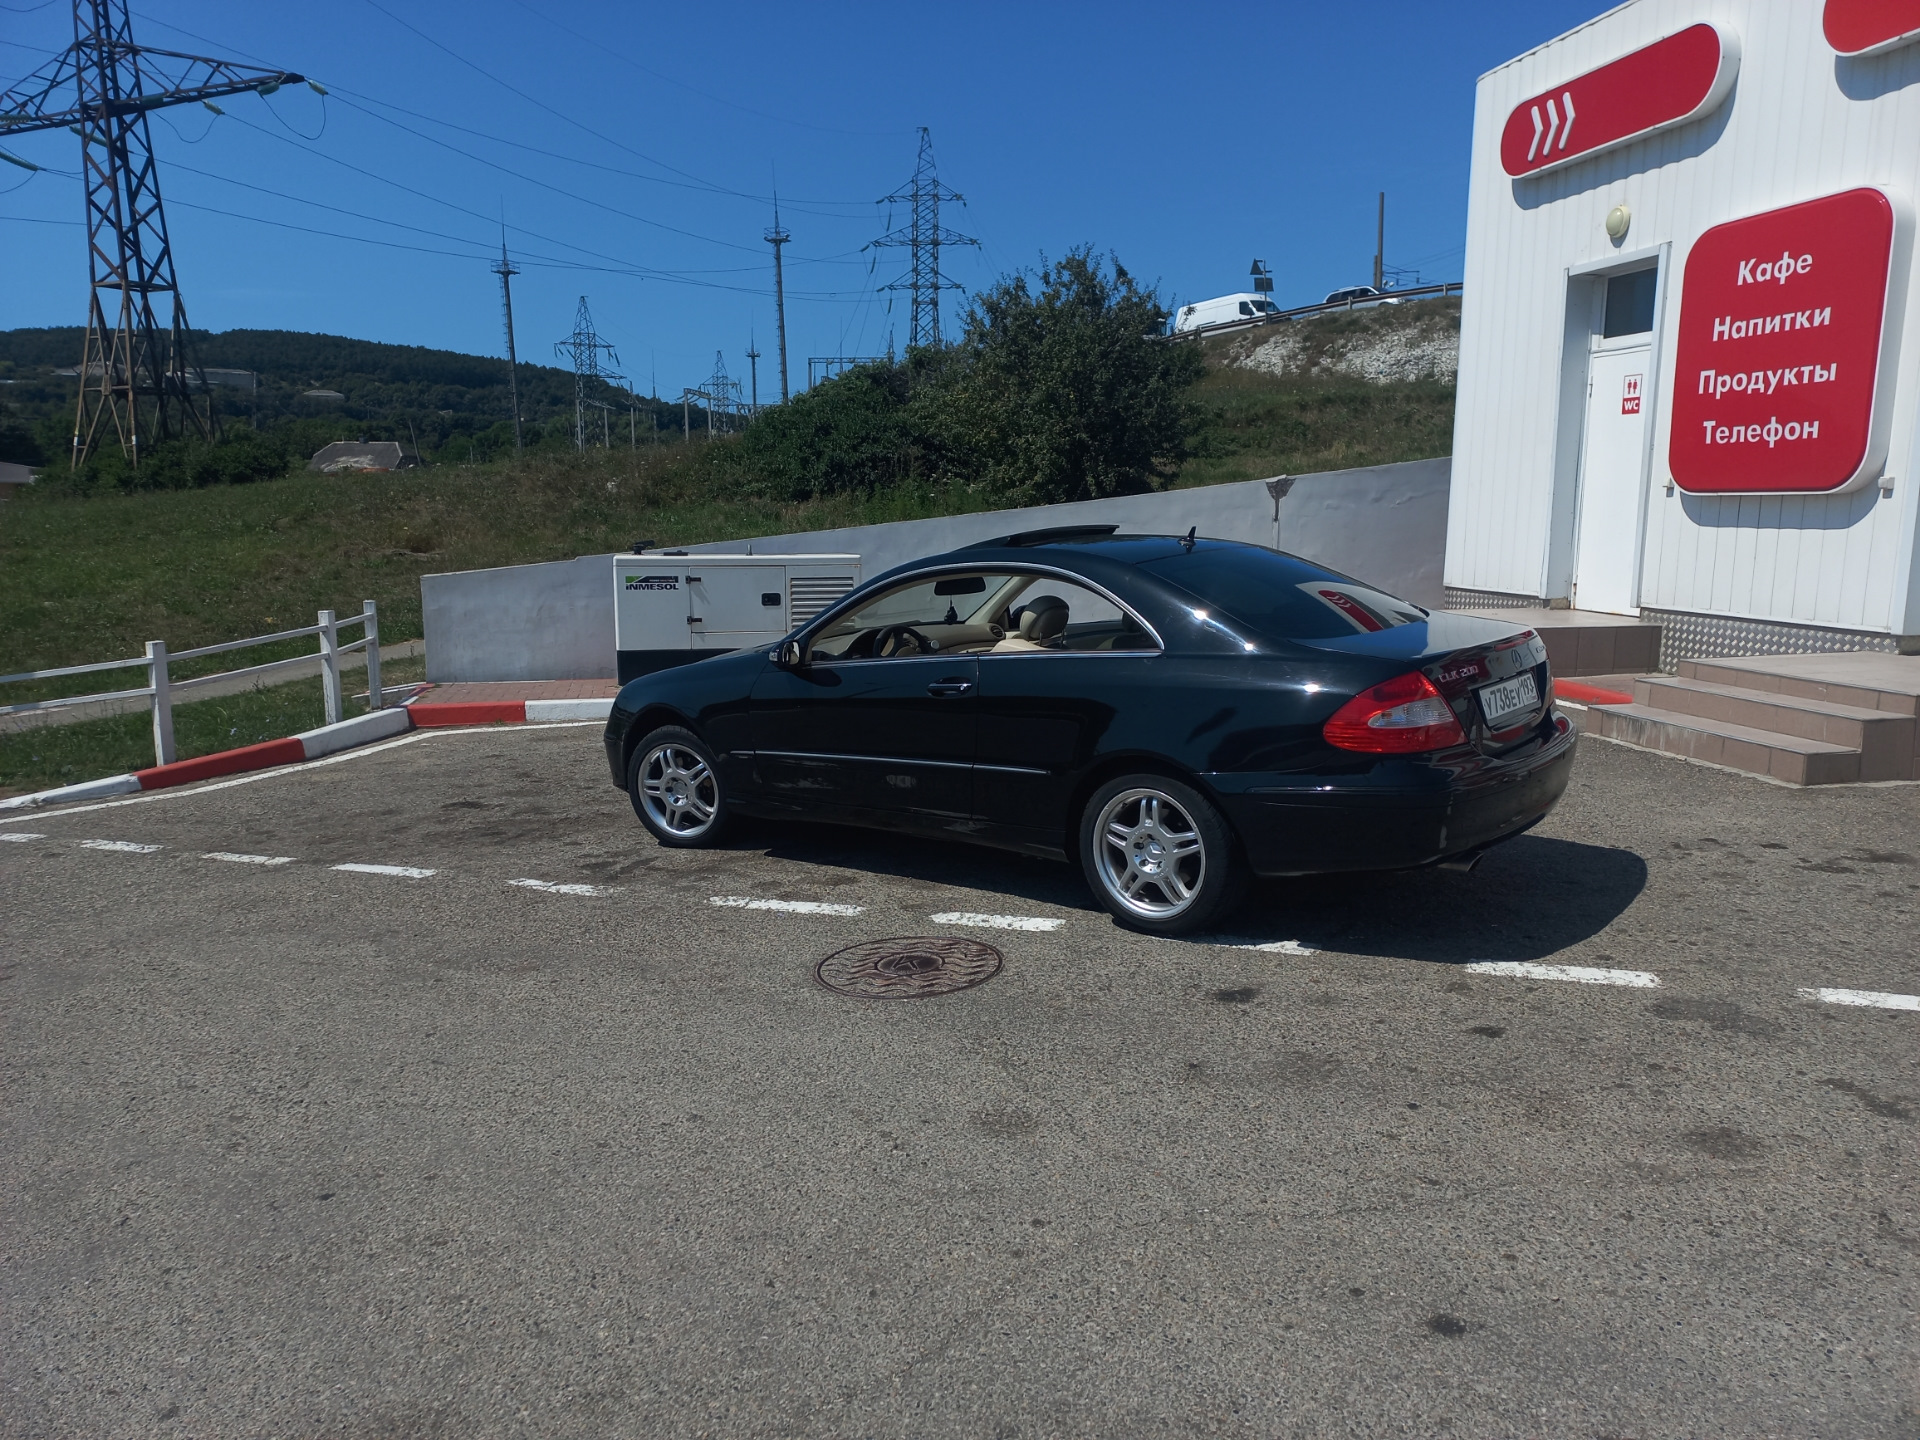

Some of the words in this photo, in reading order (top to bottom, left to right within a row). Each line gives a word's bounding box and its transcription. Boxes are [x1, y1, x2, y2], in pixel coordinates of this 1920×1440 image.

[1737, 251, 1813, 286] Кафе
[1712, 306, 1832, 342] Напитки
[1698, 362, 1838, 400] Продукты
[1624, 399, 1639, 411] WC
[1703, 416, 1820, 448] Телефон
